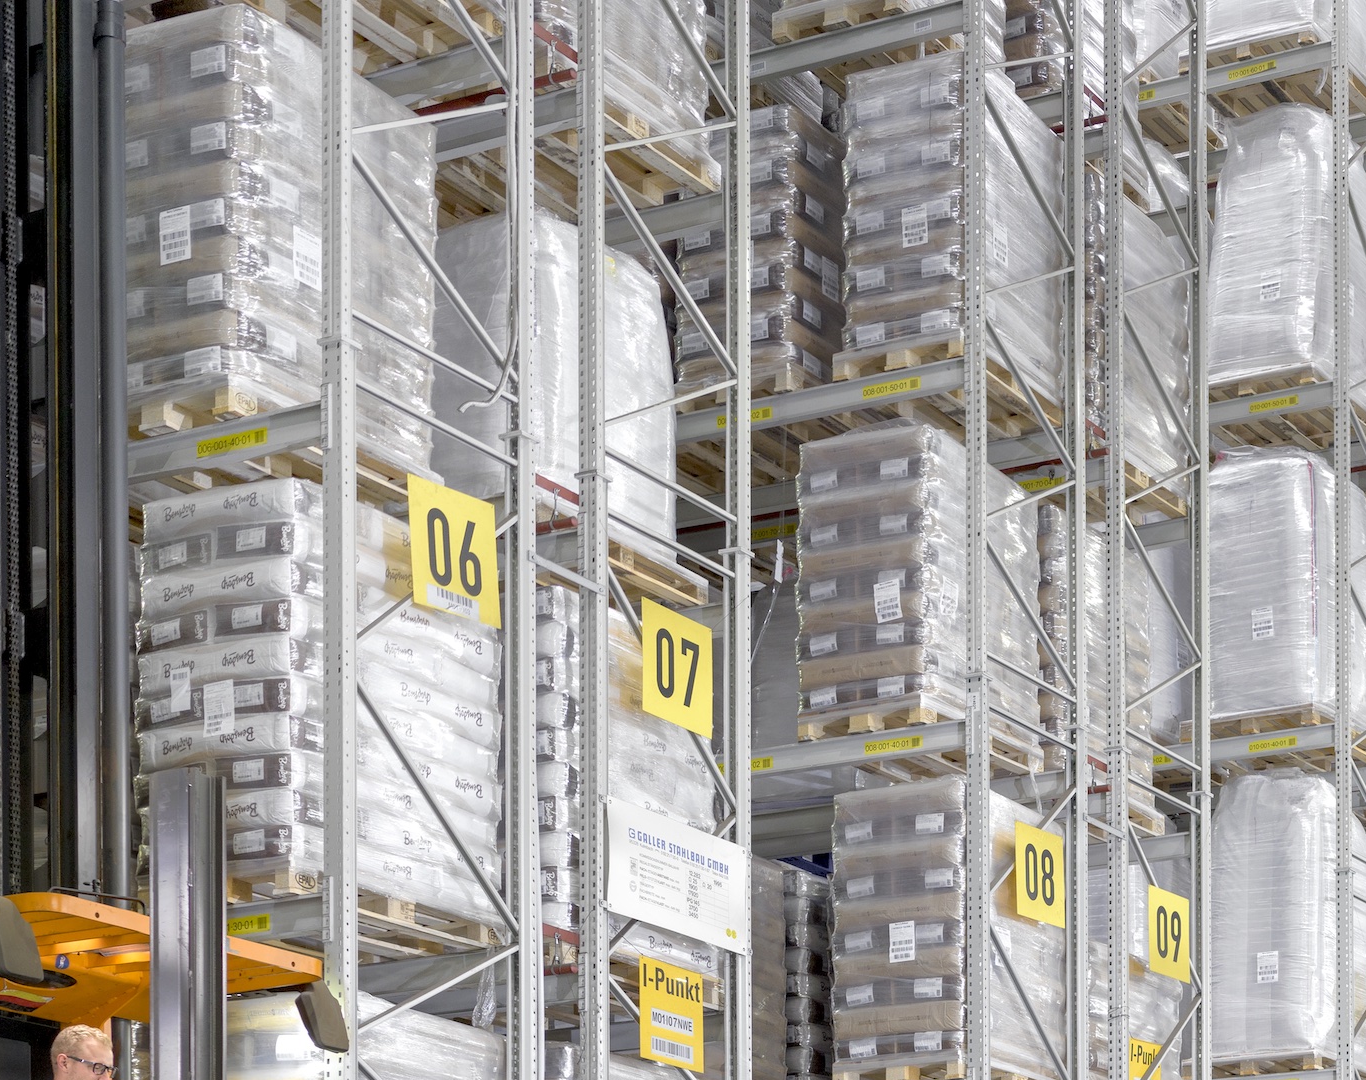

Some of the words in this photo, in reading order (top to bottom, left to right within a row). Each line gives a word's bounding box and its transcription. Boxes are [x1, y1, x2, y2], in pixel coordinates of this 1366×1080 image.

[1228, 64, 1266, 80] 010-001-60-01
[863, 381, 908, 397] 008-001-50-01
[198, 433, 252, 454] 006-001-40-01
[222, 491, 259, 511] Bensdorp
[164, 502, 196, 523] Bensdorp
[427, 507, 482, 597] 06
[221, 571, 256, 590] Bensdorp
[163, 582, 195, 602] Bensdorp
[222, 648, 257, 667] Bensdorp
[656, 628, 699, 708] 07
[162, 736, 194, 756] Bensdorp
[865, 739, 909, 753] 008-001-40-01
[637, 830, 666, 851] GALLER
[668, 842, 705, 865] STAHLBAU
[297, 873, 314, 888] EPAL
[1025, 843, 1054, 907] 08
[1157, 905, 1181, 962] 09
[643, 962, 700, 1004] I-Punkt
